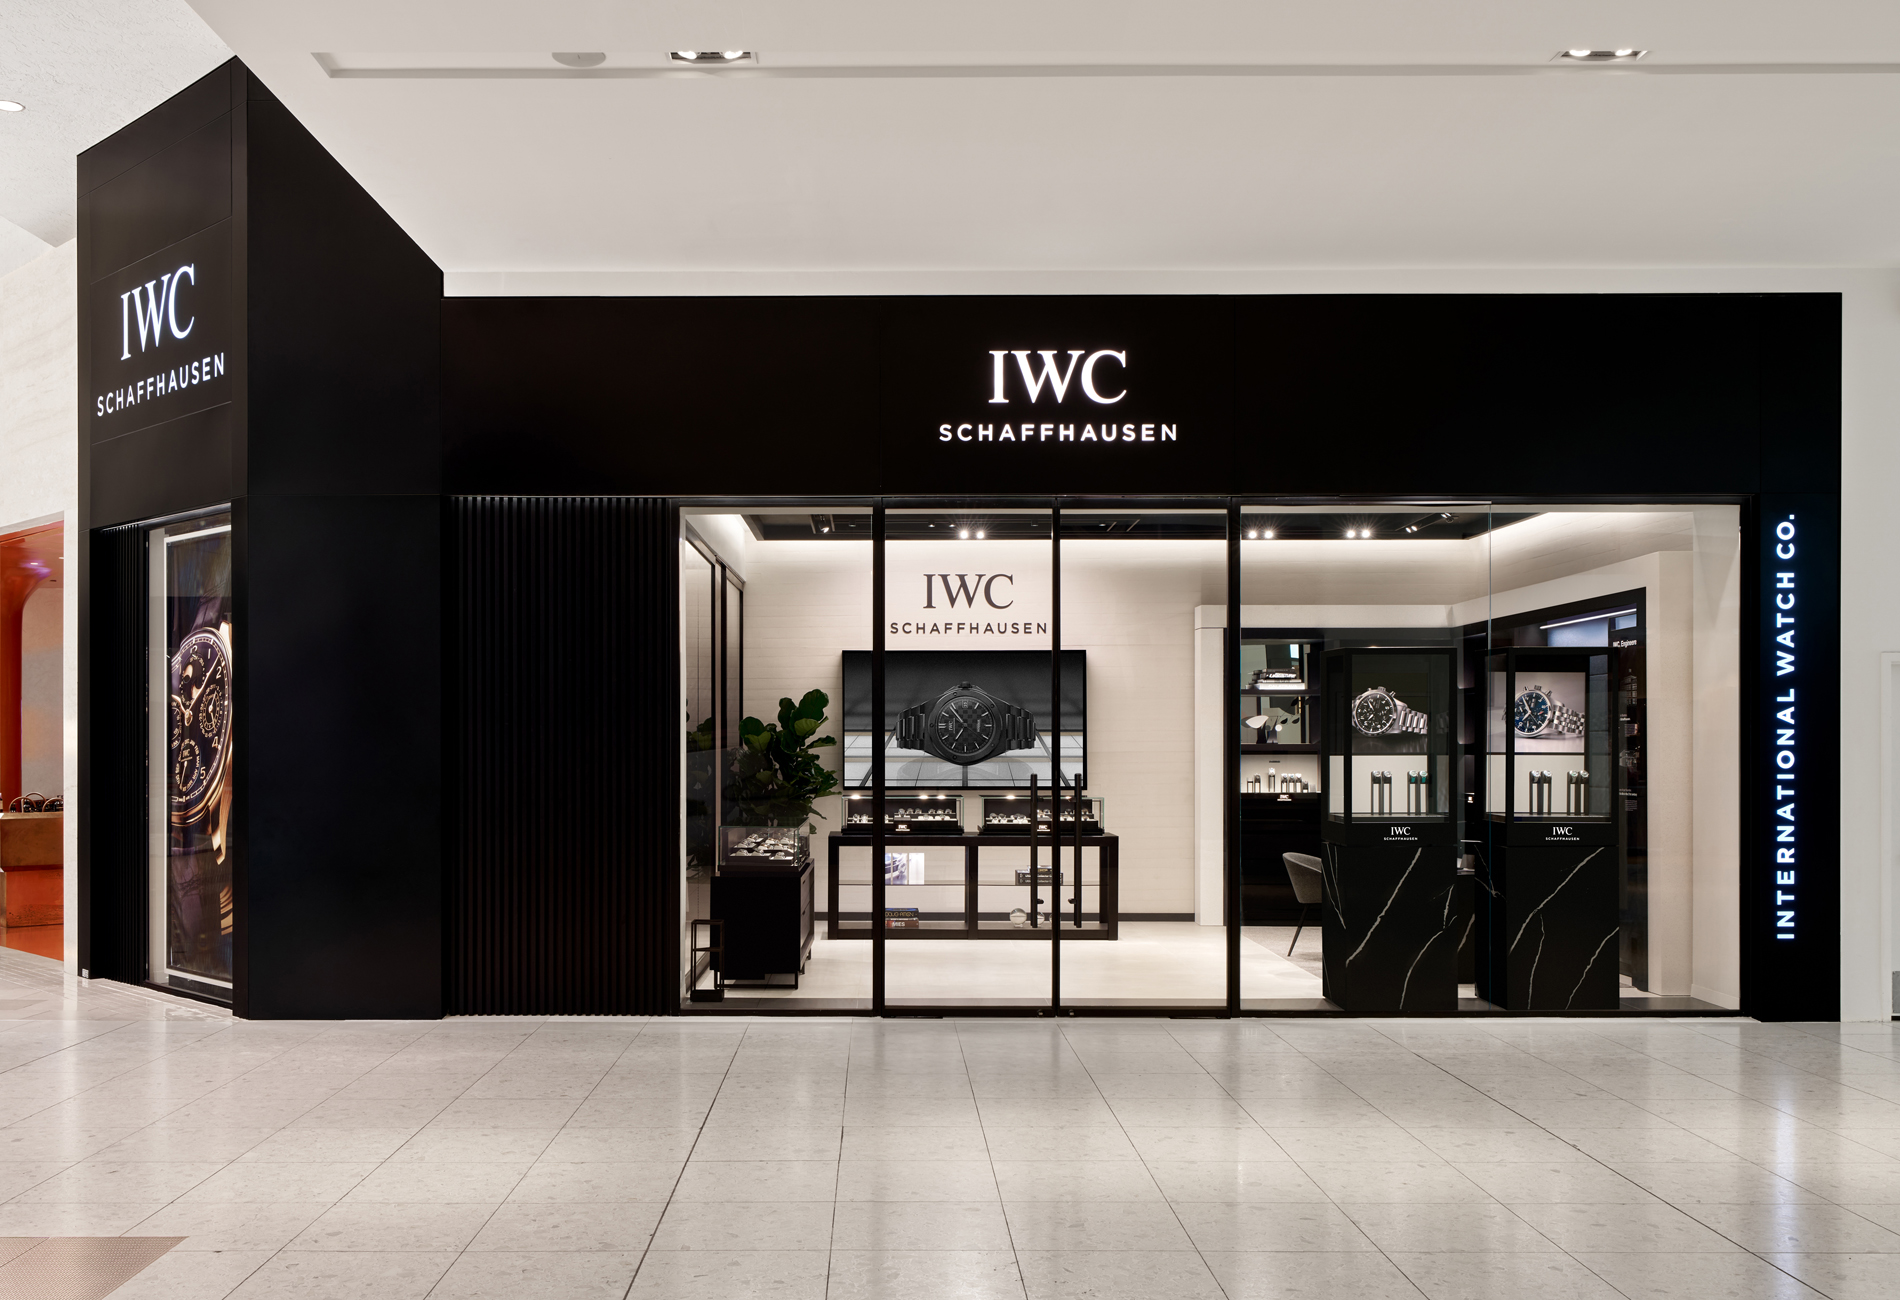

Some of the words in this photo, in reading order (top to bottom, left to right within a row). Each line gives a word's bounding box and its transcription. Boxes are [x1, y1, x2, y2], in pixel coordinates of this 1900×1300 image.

[120, 263, 195, 361] IWC
[97, 352, 225, 417] SCHAFFHAUSEN
[988, 349, 1127, 405] IWC
[939, 423, 1177, 442] SCHAFFHAUSEN
[1776, 514, 1795, 560] CO.
[923, 573, 1014, 610] IWC
[890, 622, 1047, 635] SCHAFFHAUSEN
[1776, 572, 1795, 676] WATCH
[216, 666, 222, 680] 2
[200, 766, 206, 780] 5
[1390, 826, 1411, 836] IWC
[1552, 826, 1573, 836] IWC
[1776, 688, 1795, 940] INTERNATIONAL
